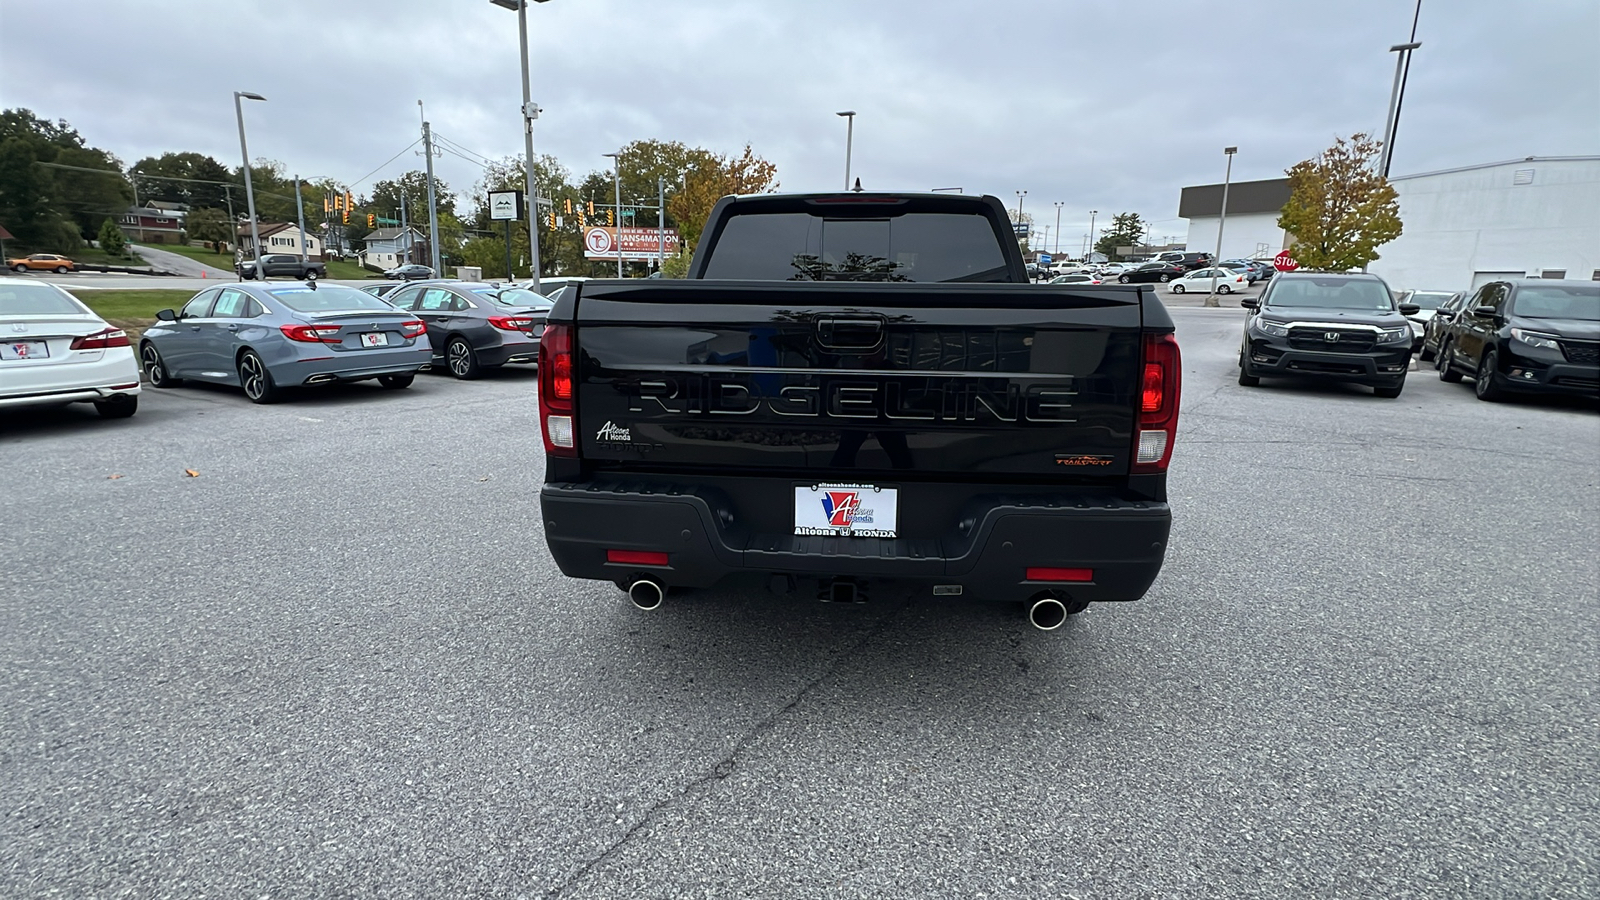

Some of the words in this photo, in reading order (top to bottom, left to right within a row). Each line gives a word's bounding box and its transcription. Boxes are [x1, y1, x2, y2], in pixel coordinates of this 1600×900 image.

[613, 234, 679, 243] TRANS4MAION
[628, 375, 1079, 422] RIDGELINE
[596, 420, 630, 440] Altoona
[610, 433, 631, 441] Honda
[847, 515, 874, 523] Honda
[794, 527, 837, 536] Altoona
[853, 529, 897, 538] HONDA
